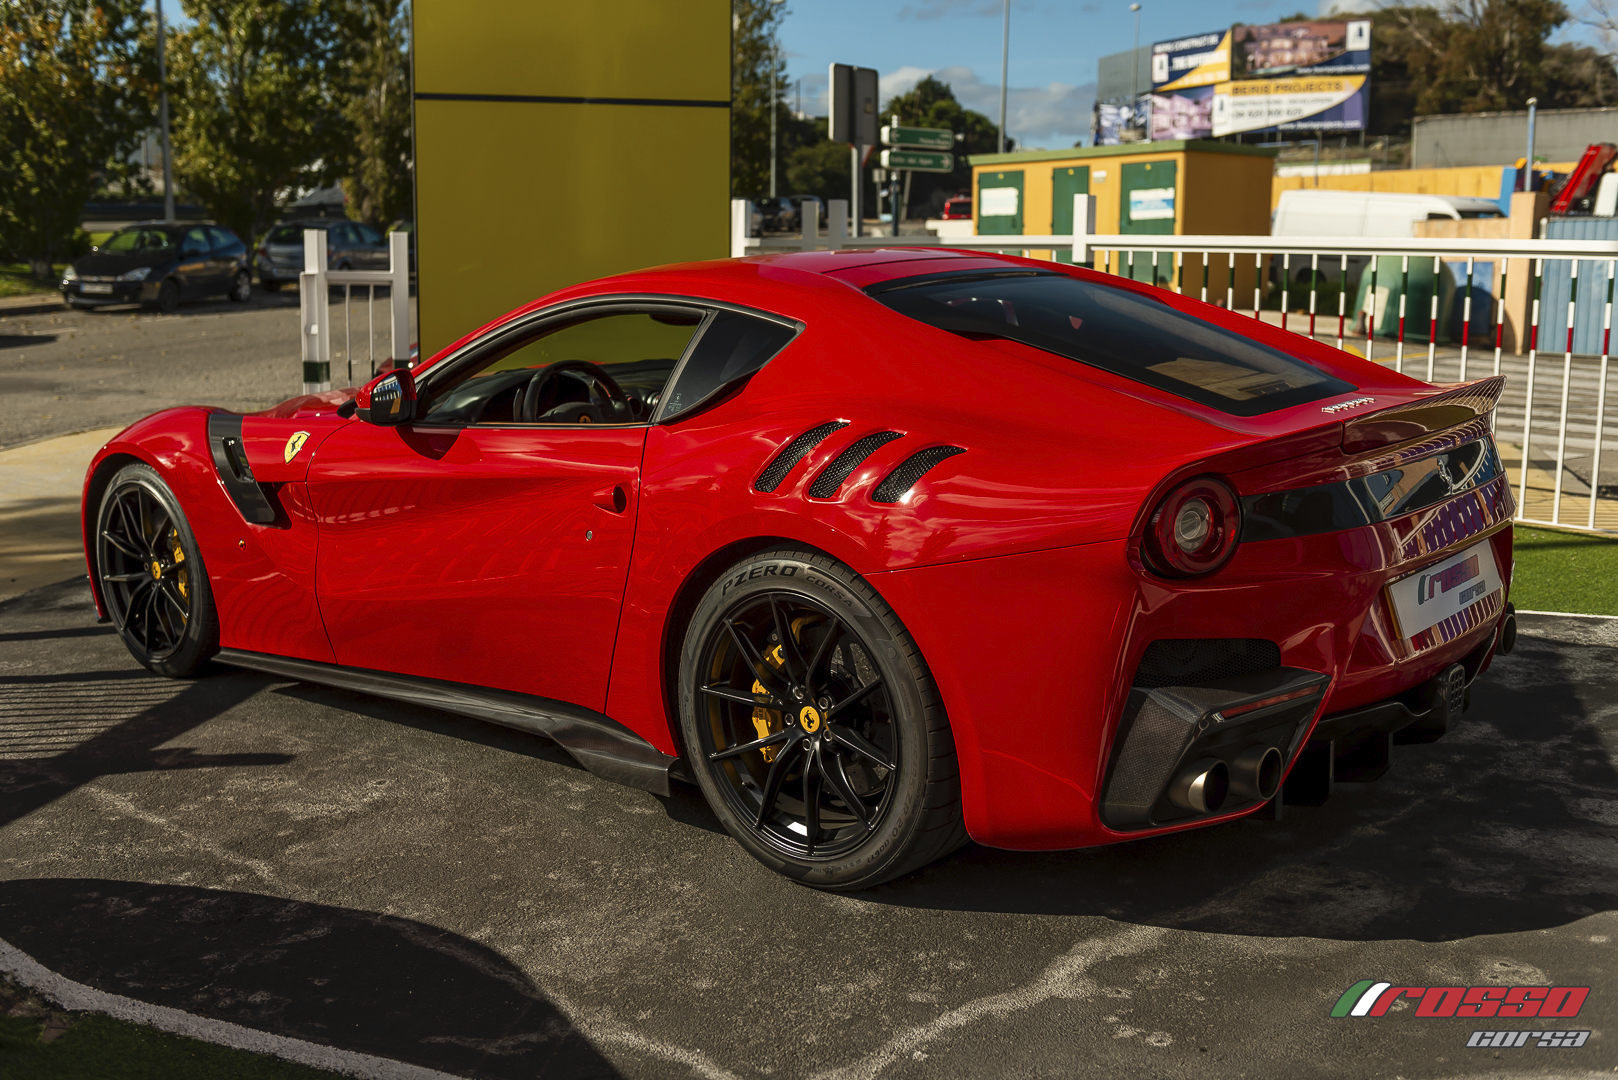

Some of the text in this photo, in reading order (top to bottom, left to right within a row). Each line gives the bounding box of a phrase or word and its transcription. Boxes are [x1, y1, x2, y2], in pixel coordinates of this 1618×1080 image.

[1273, 80, 1343, 94] PROJECTS
[805, 575, 853, 608] CORSA
[1428, 554, 1480, 600] rosso
[1459, 580, 1487, 605] corsa
